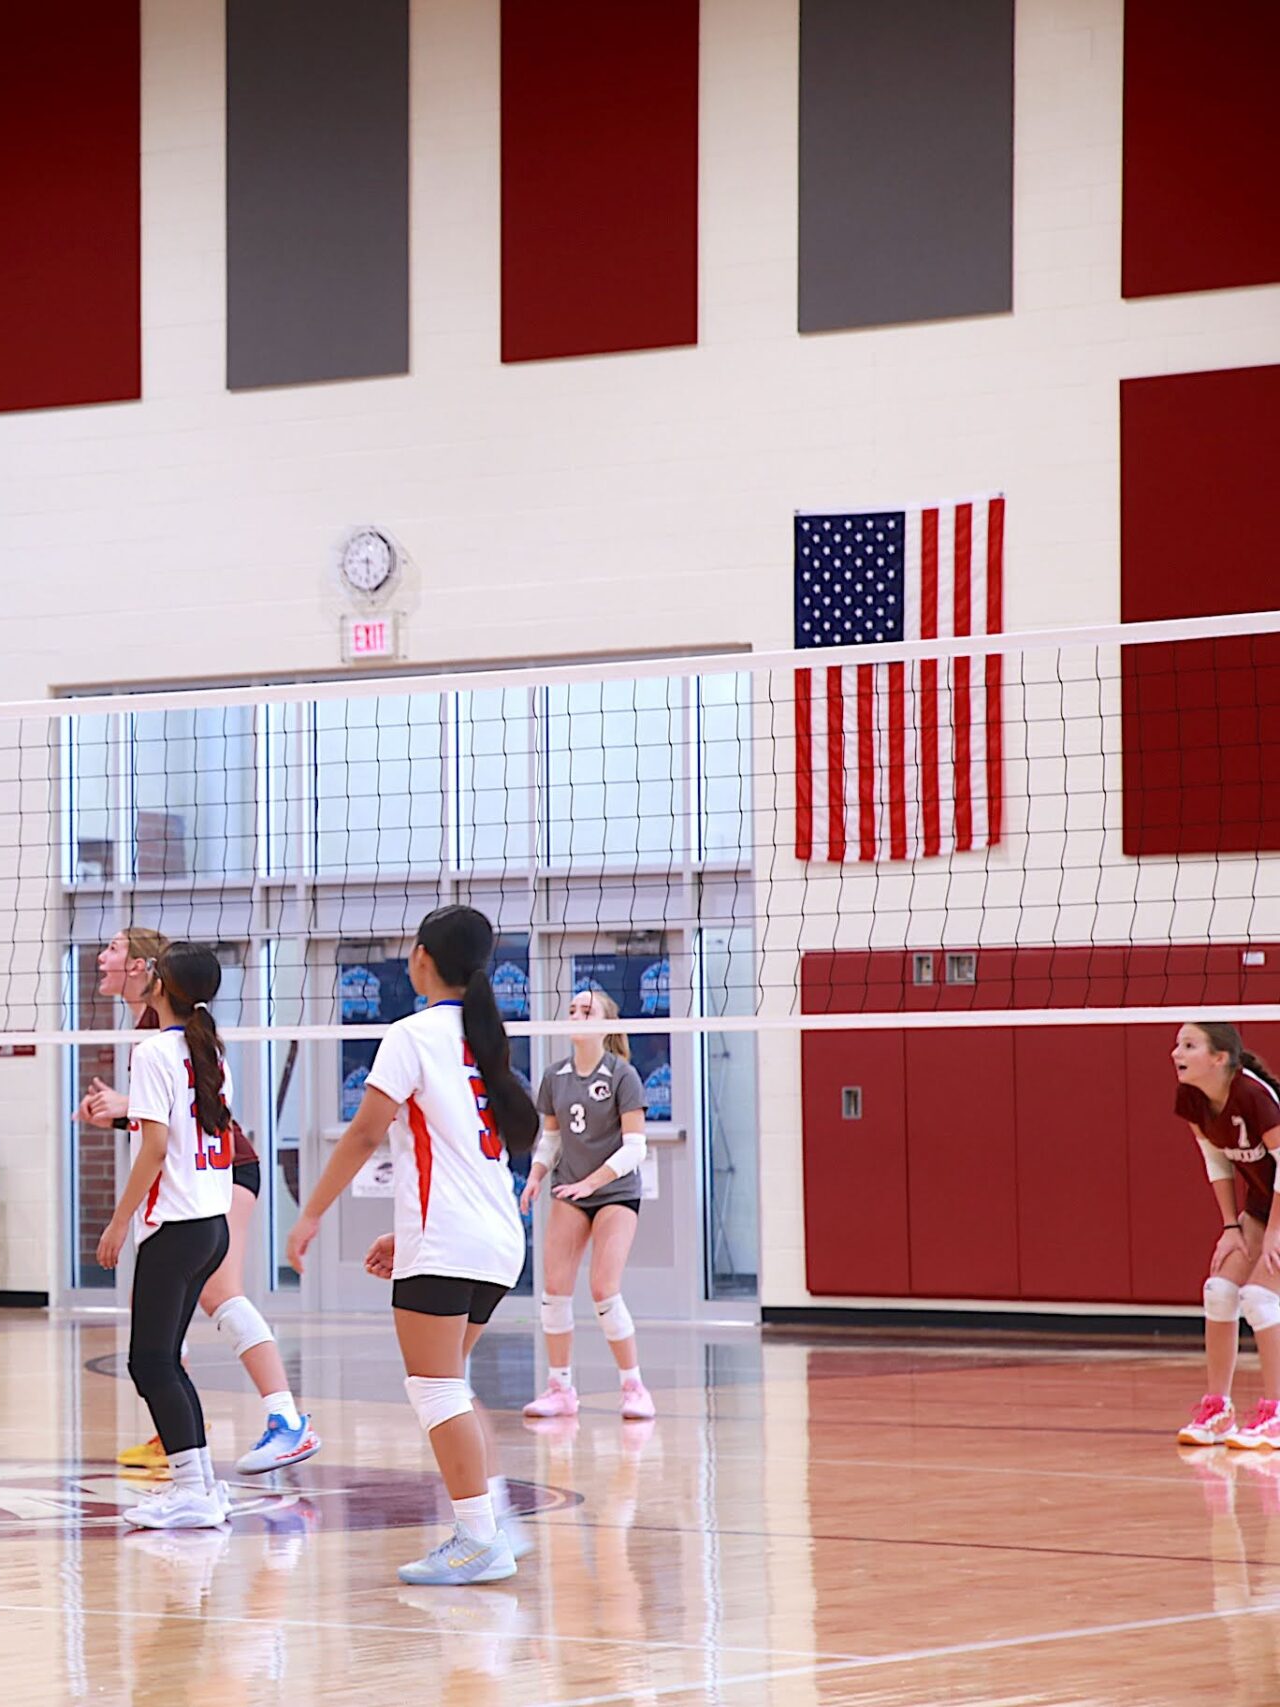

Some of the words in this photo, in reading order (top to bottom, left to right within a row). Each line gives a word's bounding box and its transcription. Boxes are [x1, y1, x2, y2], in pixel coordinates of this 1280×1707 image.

[353, 623, 385, 652] EXIT
[569, 1103, 587, 1134] 3
[1231, 1115, 1251, 1149] 7
